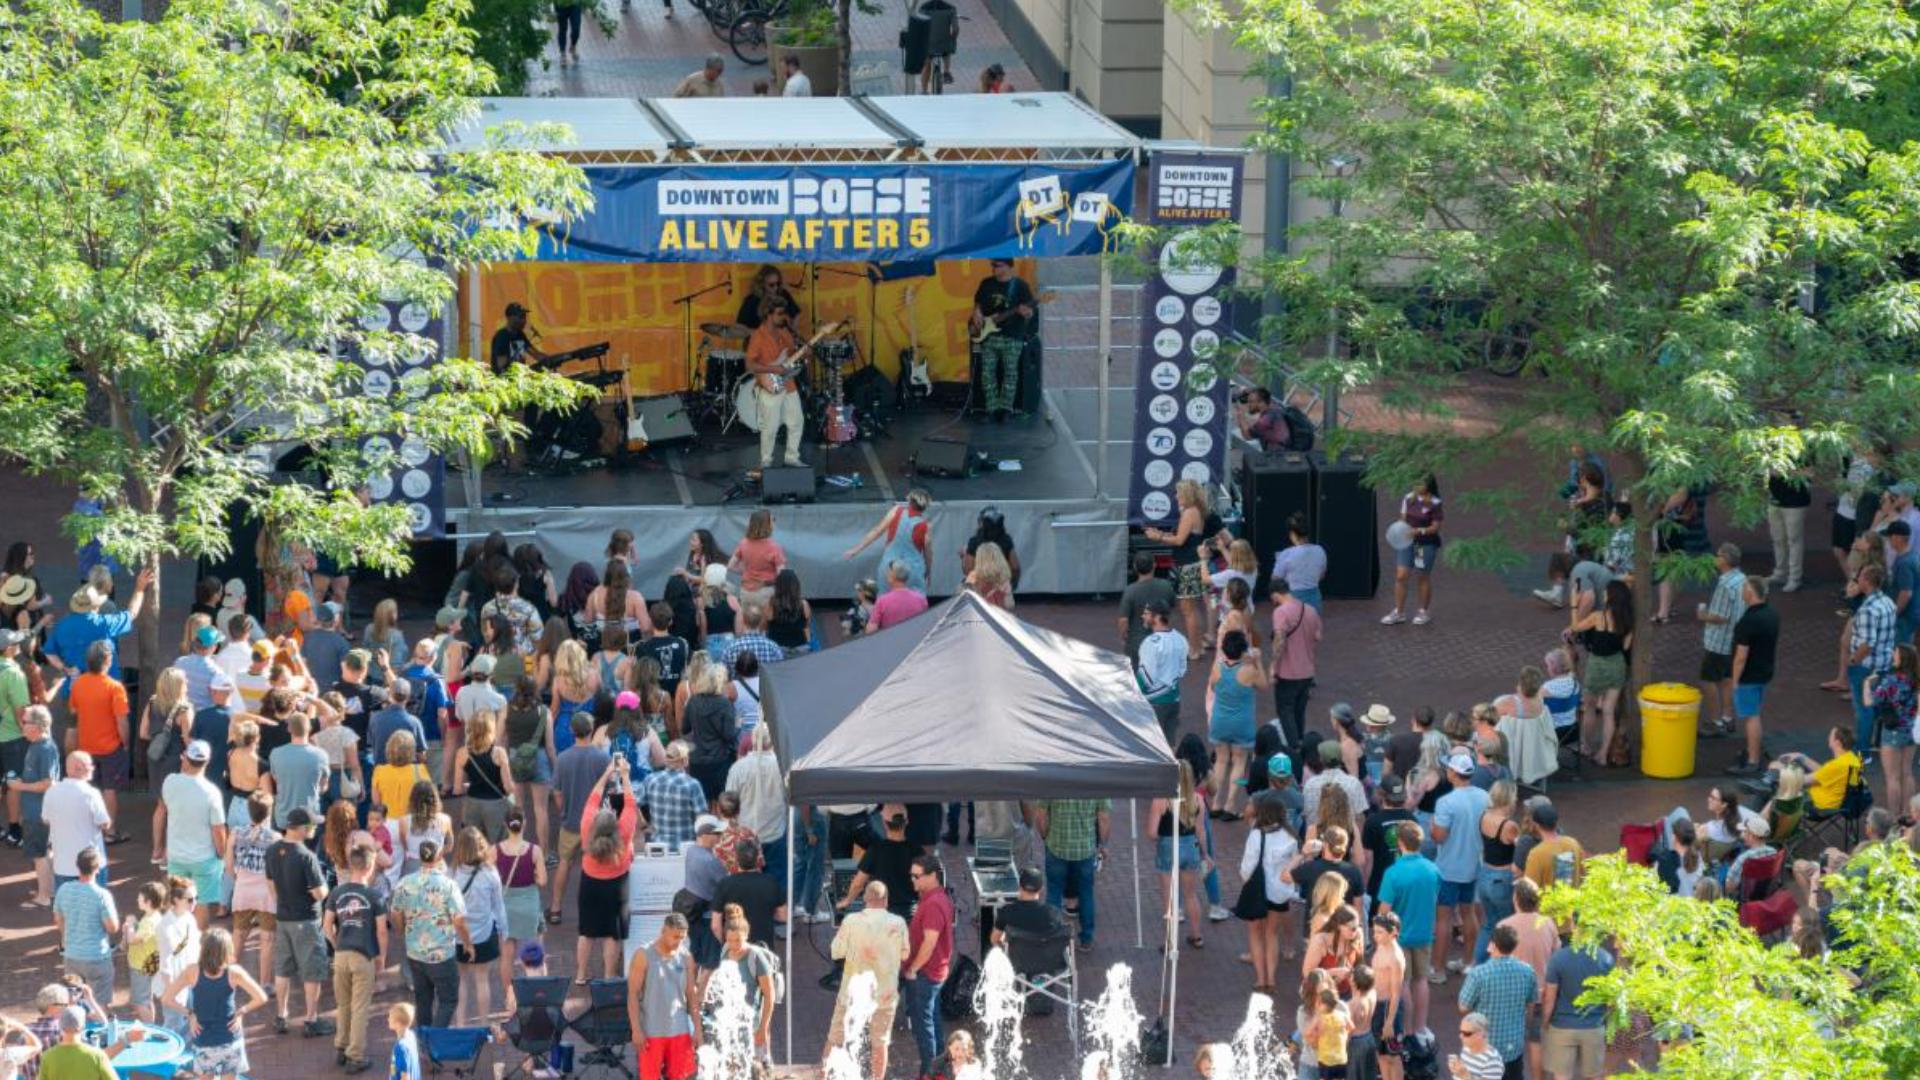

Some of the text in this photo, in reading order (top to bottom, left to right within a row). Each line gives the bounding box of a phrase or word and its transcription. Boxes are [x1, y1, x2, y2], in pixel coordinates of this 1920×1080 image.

[1164, 170, 1228, 181] DOWNTOWN
[666, 189, 780, 205] DOWNTOWN
[1028, 186, 1054, 206] DT
[1080, 199, 1101, 214] DT
[1158, 208, 1188, 218] ALIVE
[1190, 208, 1223, 218] AFTER
[658, 217, 932, 250] ALIVE AFTER 5
